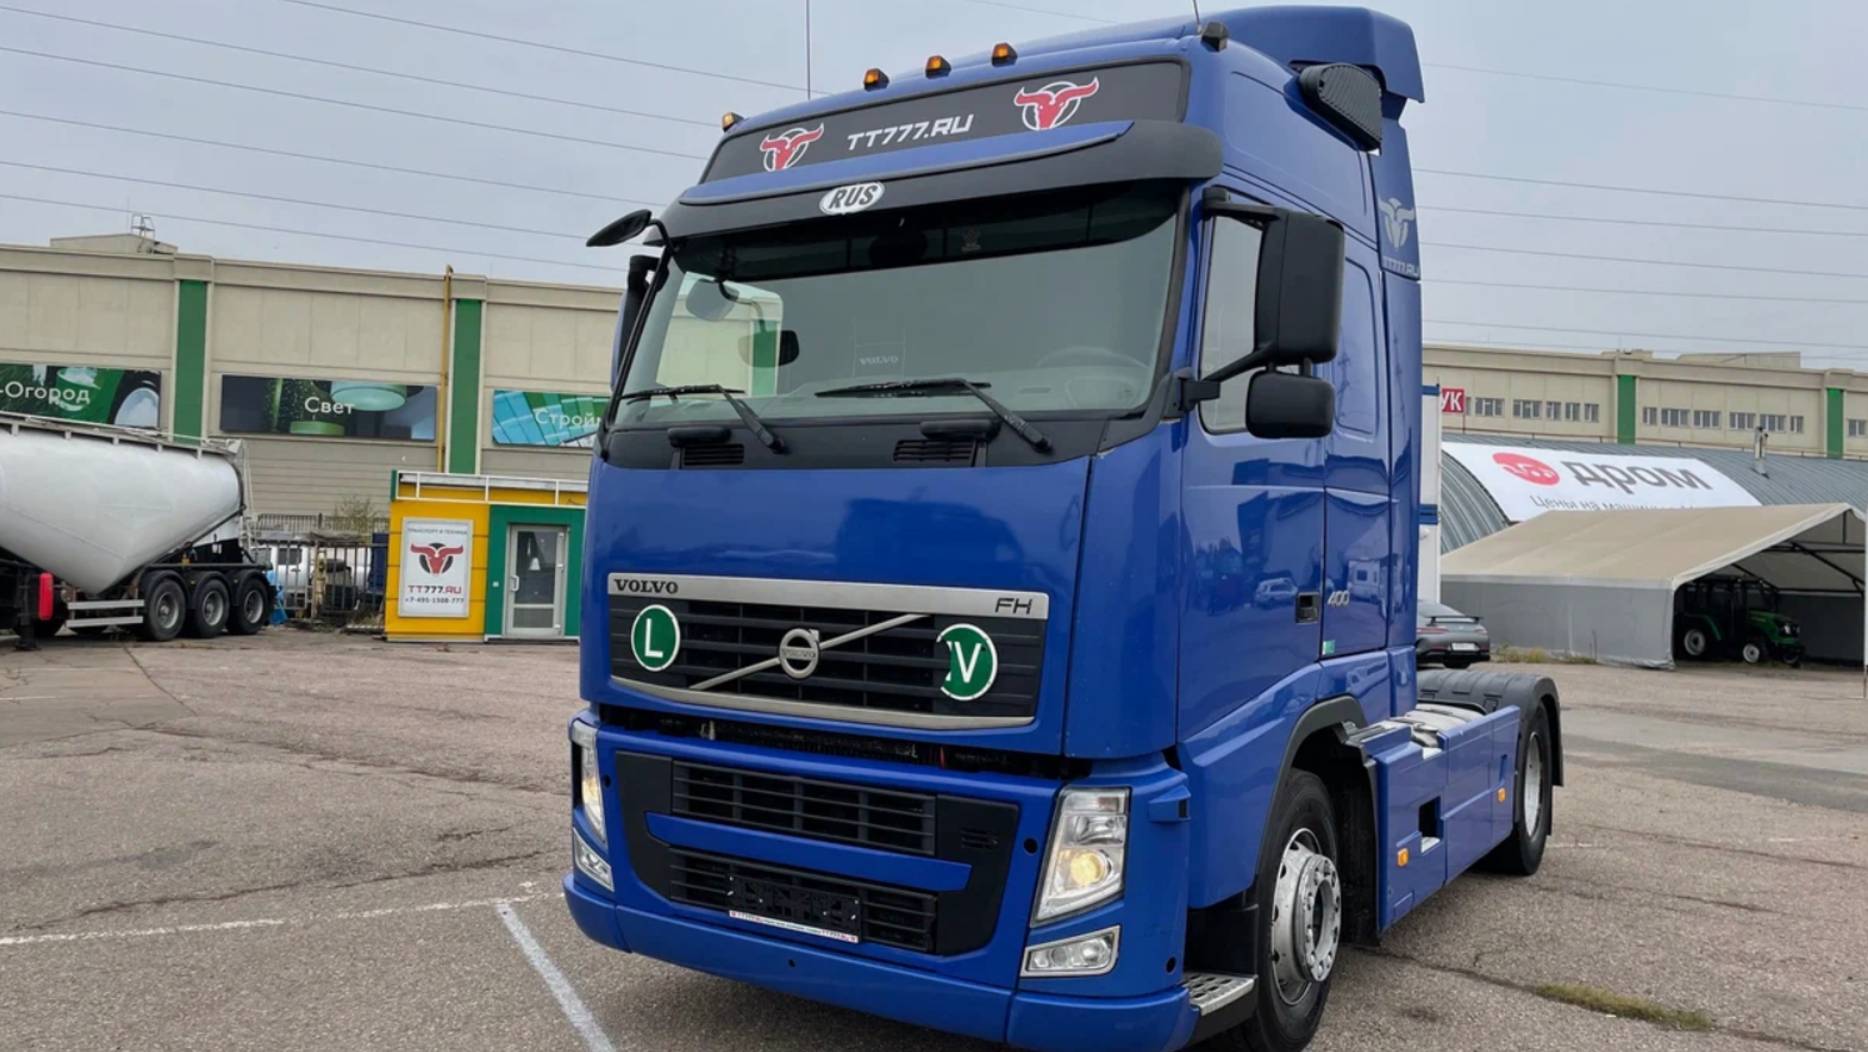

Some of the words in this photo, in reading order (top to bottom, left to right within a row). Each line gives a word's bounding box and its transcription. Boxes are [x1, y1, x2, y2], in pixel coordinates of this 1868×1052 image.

[847, 114, 974, 151] TT777.RU
[828, 185, 879, 210] RUS
[304, 396, 354, 415] Свет
[408, 584, 462, 594] TT777.RU
[614, 579, 679, 594] VOLVO
[995, 598, 1032, 614] FH
[645, 618, 663, 658] L
